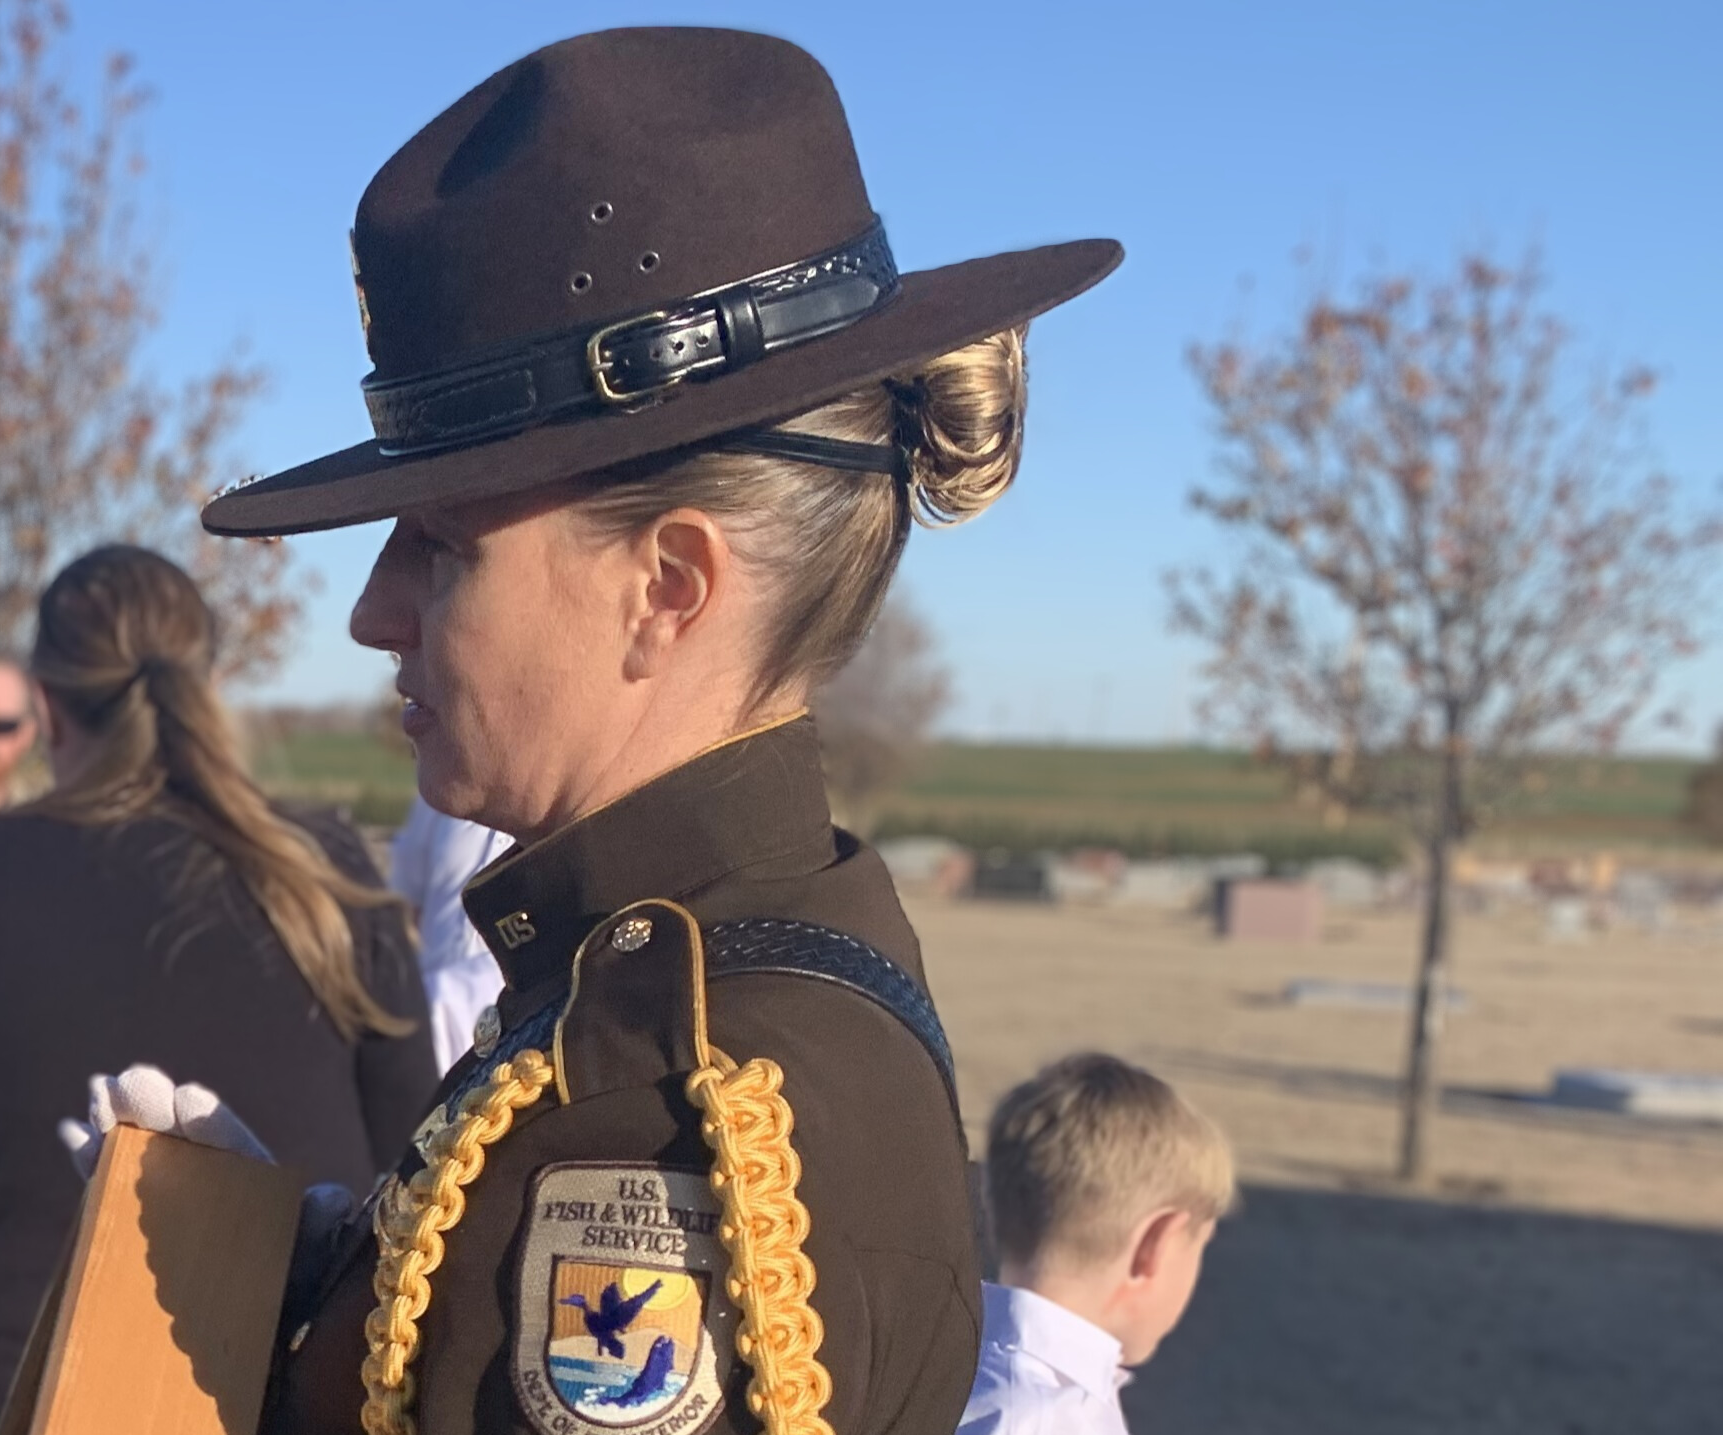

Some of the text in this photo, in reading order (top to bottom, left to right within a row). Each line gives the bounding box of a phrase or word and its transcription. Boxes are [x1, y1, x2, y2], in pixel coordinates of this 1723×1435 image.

[495, 911, 536, 949] US
[619, 1180, 661, 1202] U.S.
[544, 1201, 721, 1234] FISH & WILDLIF
[583, 1225, 685, 1254] SERVICE
